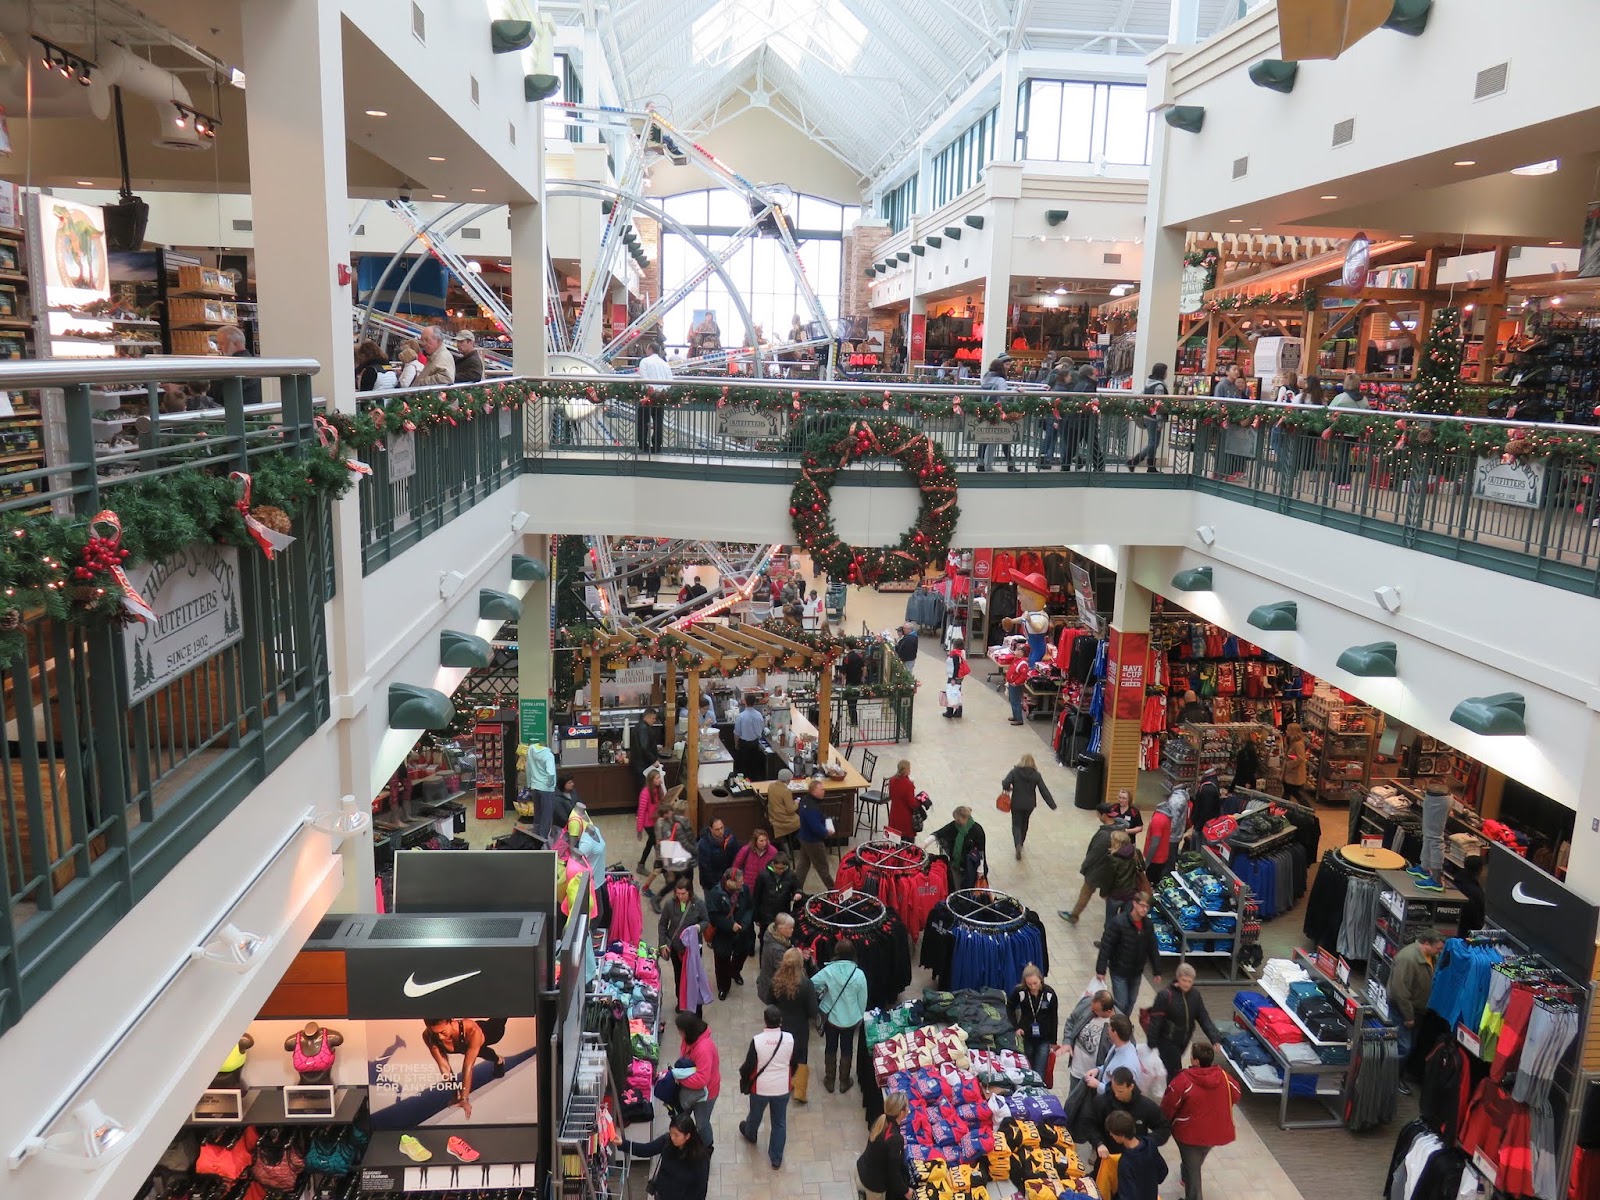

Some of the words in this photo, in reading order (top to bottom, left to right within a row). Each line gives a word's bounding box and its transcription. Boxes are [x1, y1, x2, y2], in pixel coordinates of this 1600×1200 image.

[1488, 476, 1526, 488] OUTFITTERS
[153, 589, 219, 639] OUTFITTERS
[166, 644, 192, 668] SINCE
[193, 634, 209, 652] 1902
[624, 669, 645, 677] PLEASE
[1436, 906, 1461, 914] PROTECT
[375, 1063, 435, 1073] SOFTNESS
[375, 1073, 401, 1082] AND
[404, 1072, 458, 1082] STRETCH
[376, 1082, 399, 1092] FOR
[402, 1082, 427, 1092] ANY
[429, 1081, 466, 1092] FORM.
